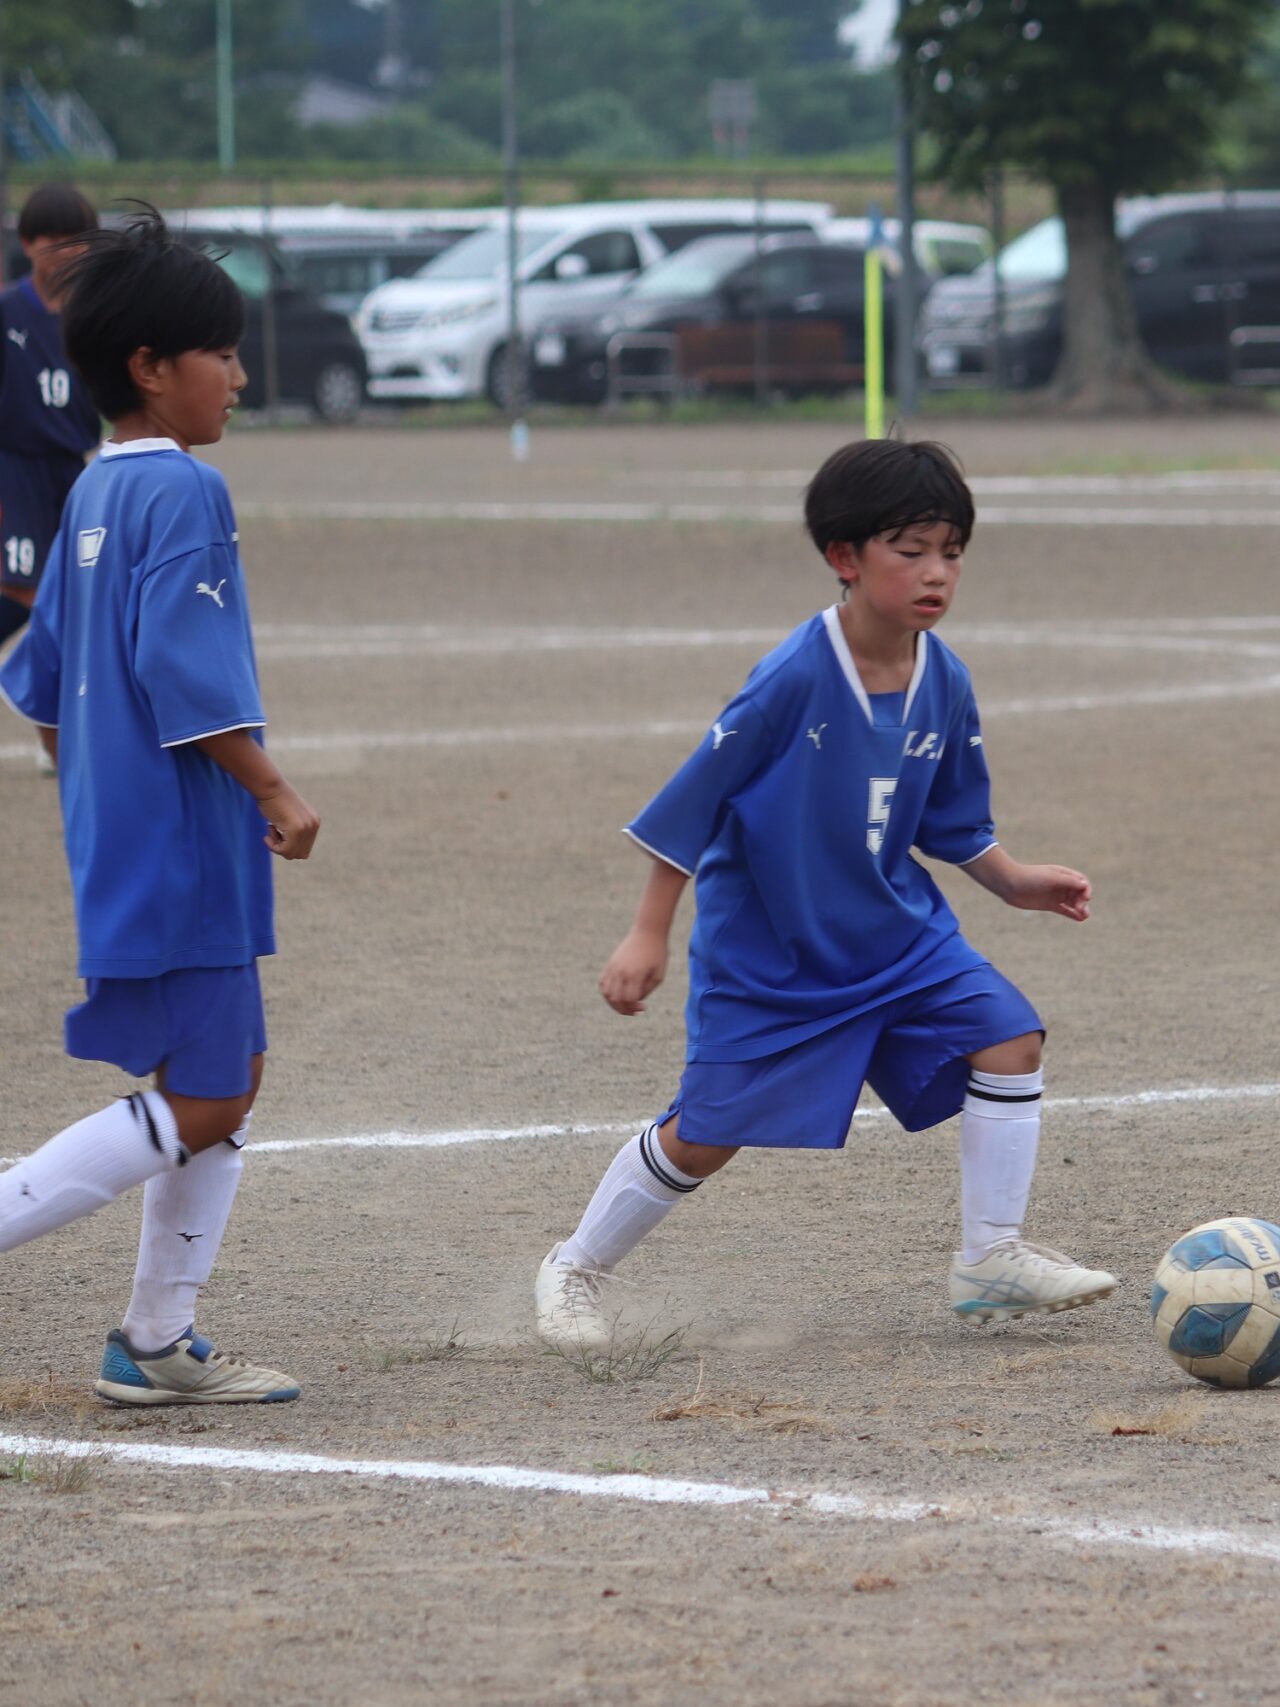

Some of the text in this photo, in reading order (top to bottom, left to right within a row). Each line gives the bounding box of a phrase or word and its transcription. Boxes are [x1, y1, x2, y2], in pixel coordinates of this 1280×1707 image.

[37, 367, 70, 408] 19
[5, 535, 35, 576] 19
[866, 777, 899, 855] 5
